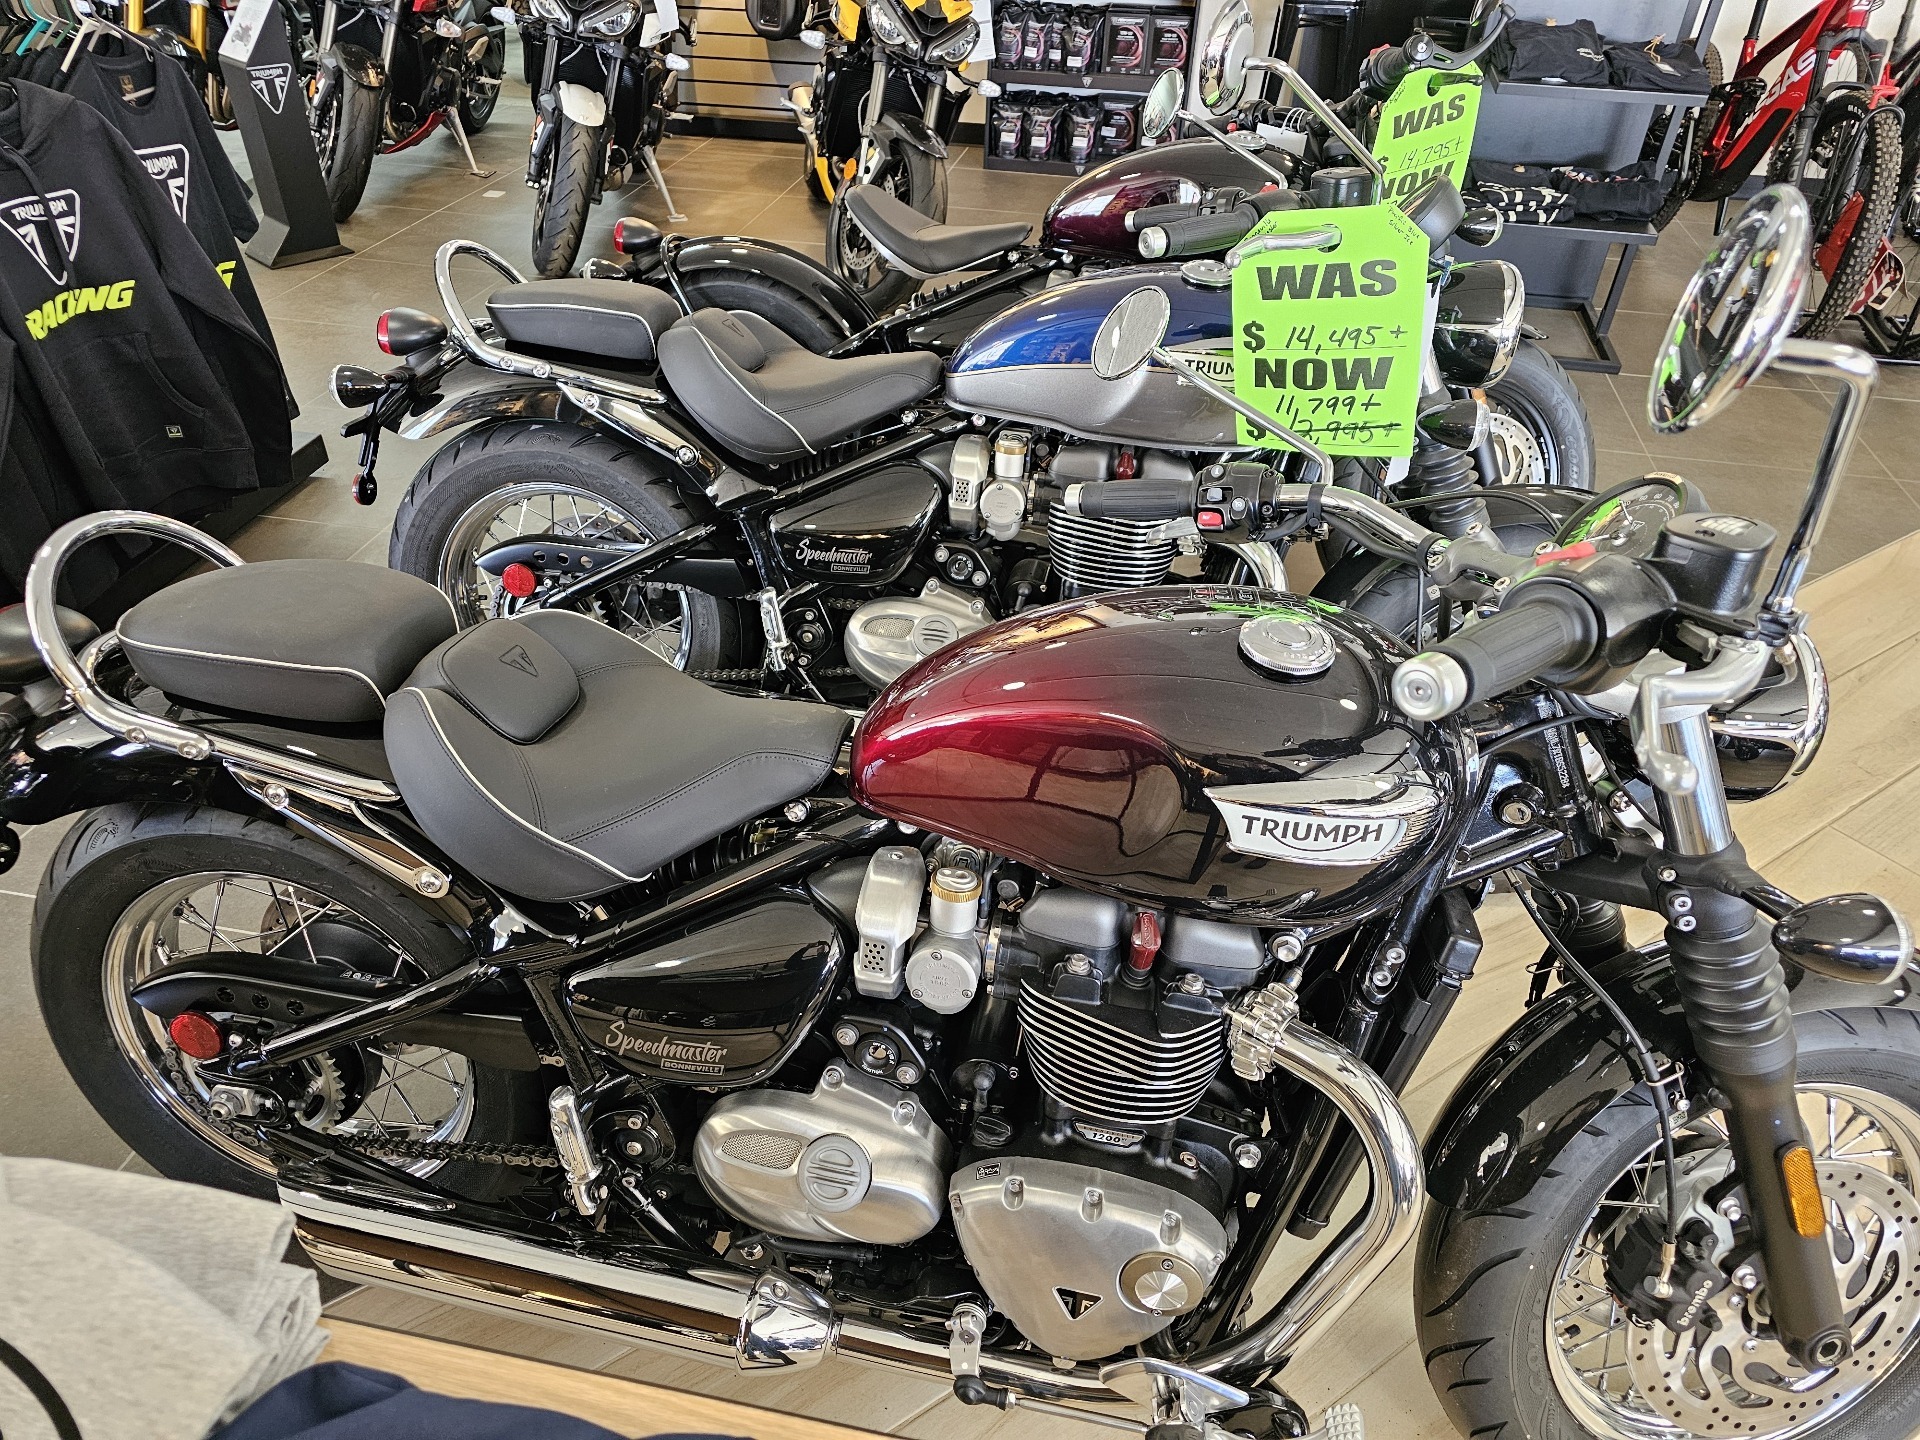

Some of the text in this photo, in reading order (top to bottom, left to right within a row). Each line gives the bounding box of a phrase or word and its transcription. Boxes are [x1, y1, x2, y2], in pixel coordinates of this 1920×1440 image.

[250, 67, 284, 80] TRIUMPH
[1393, 93, 1467, 140] WAS
[141, 155, 178, 180] IUMPH
[1256, 259, 1398, 301] WAS
[25, 279, 136, 341] RACING
[1242, 320, 1266, 353] $
[1184, 358, 1235, 382] TRIUM
[1254, 356, 1395, 391] NOW
[795, 538, 873, 566] Speedmaster
[833, 565, 868, 573] BONNEVILLE
[1241, 814, 1384, 852] TRIUMPH
[605, 1020, 728, 1062] Speedmaster
[664, 1061, 720, 1073] BONNEVILLE
[1092, 1132, 1121, 1143] 1200
[1676, 1279, 1713, 1327] brembo
